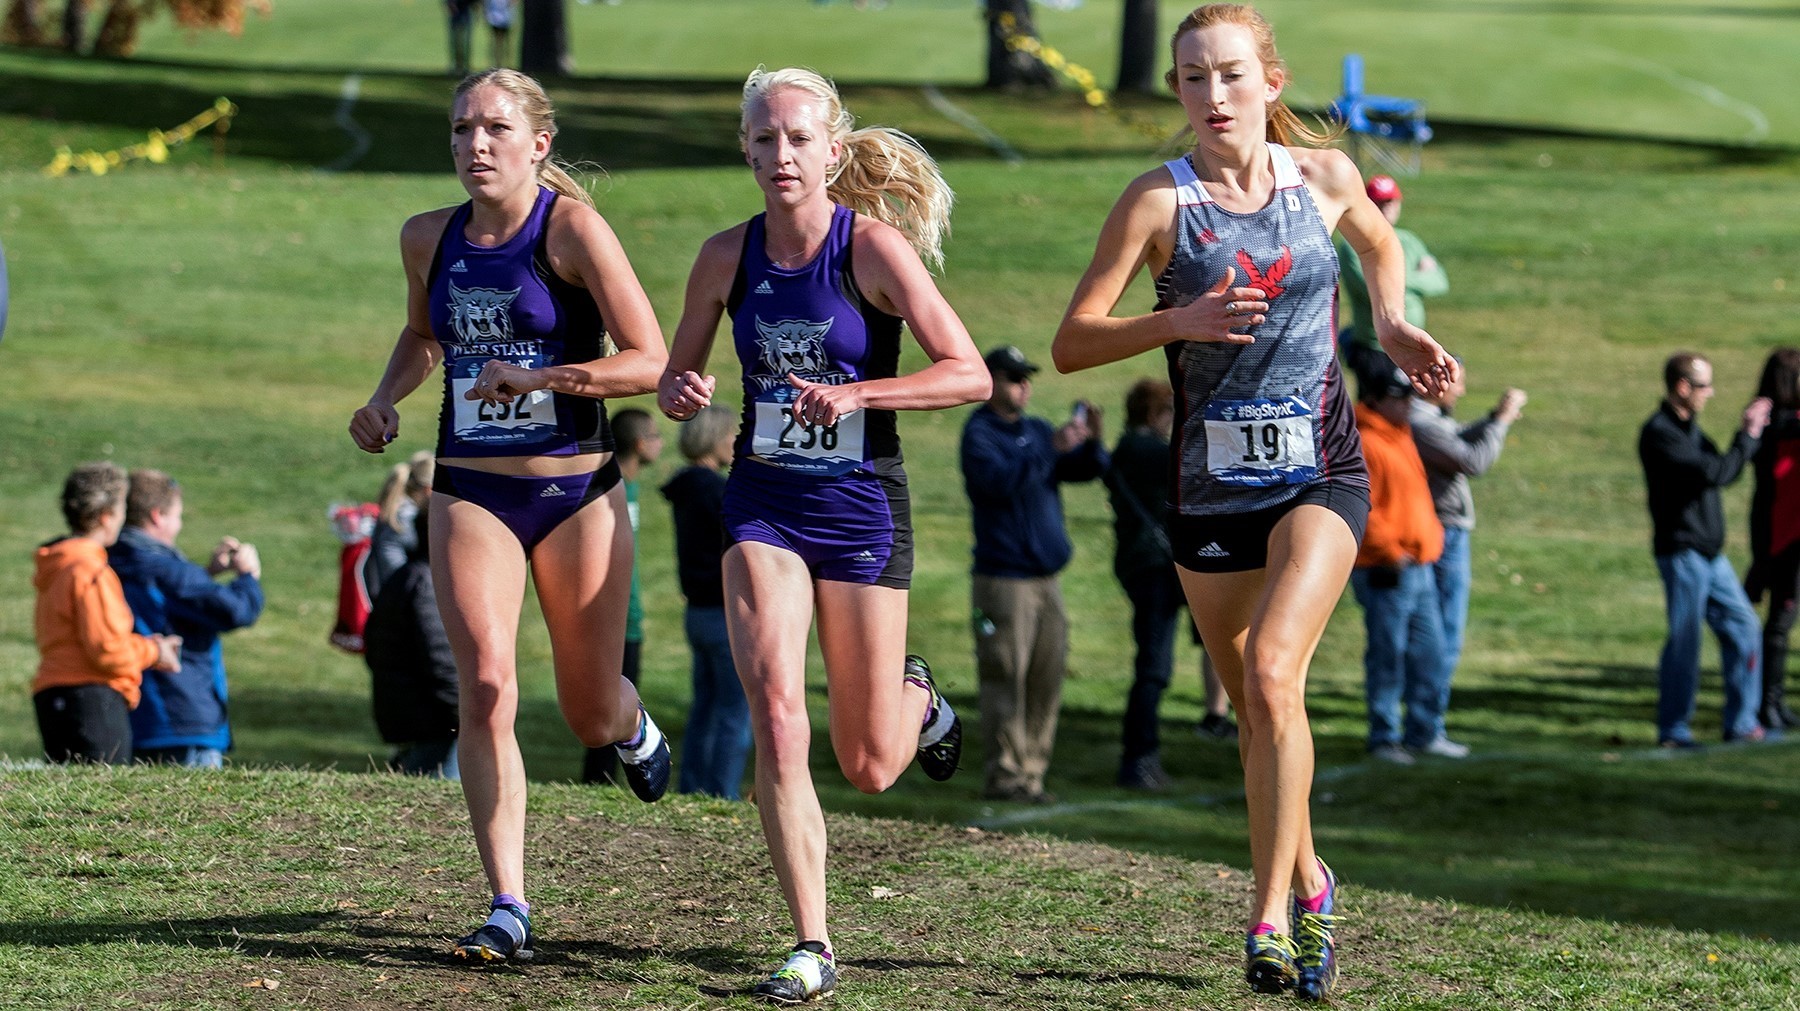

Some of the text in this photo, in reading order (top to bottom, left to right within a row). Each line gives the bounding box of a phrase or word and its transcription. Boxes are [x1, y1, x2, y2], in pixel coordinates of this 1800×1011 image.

[491, 341, 538, 356] STATE
[1238, 401, 1296, 420] #BigSkyXC
[779, 408, 838, 450] 238
[1241, 423, 1279, 462] 19
